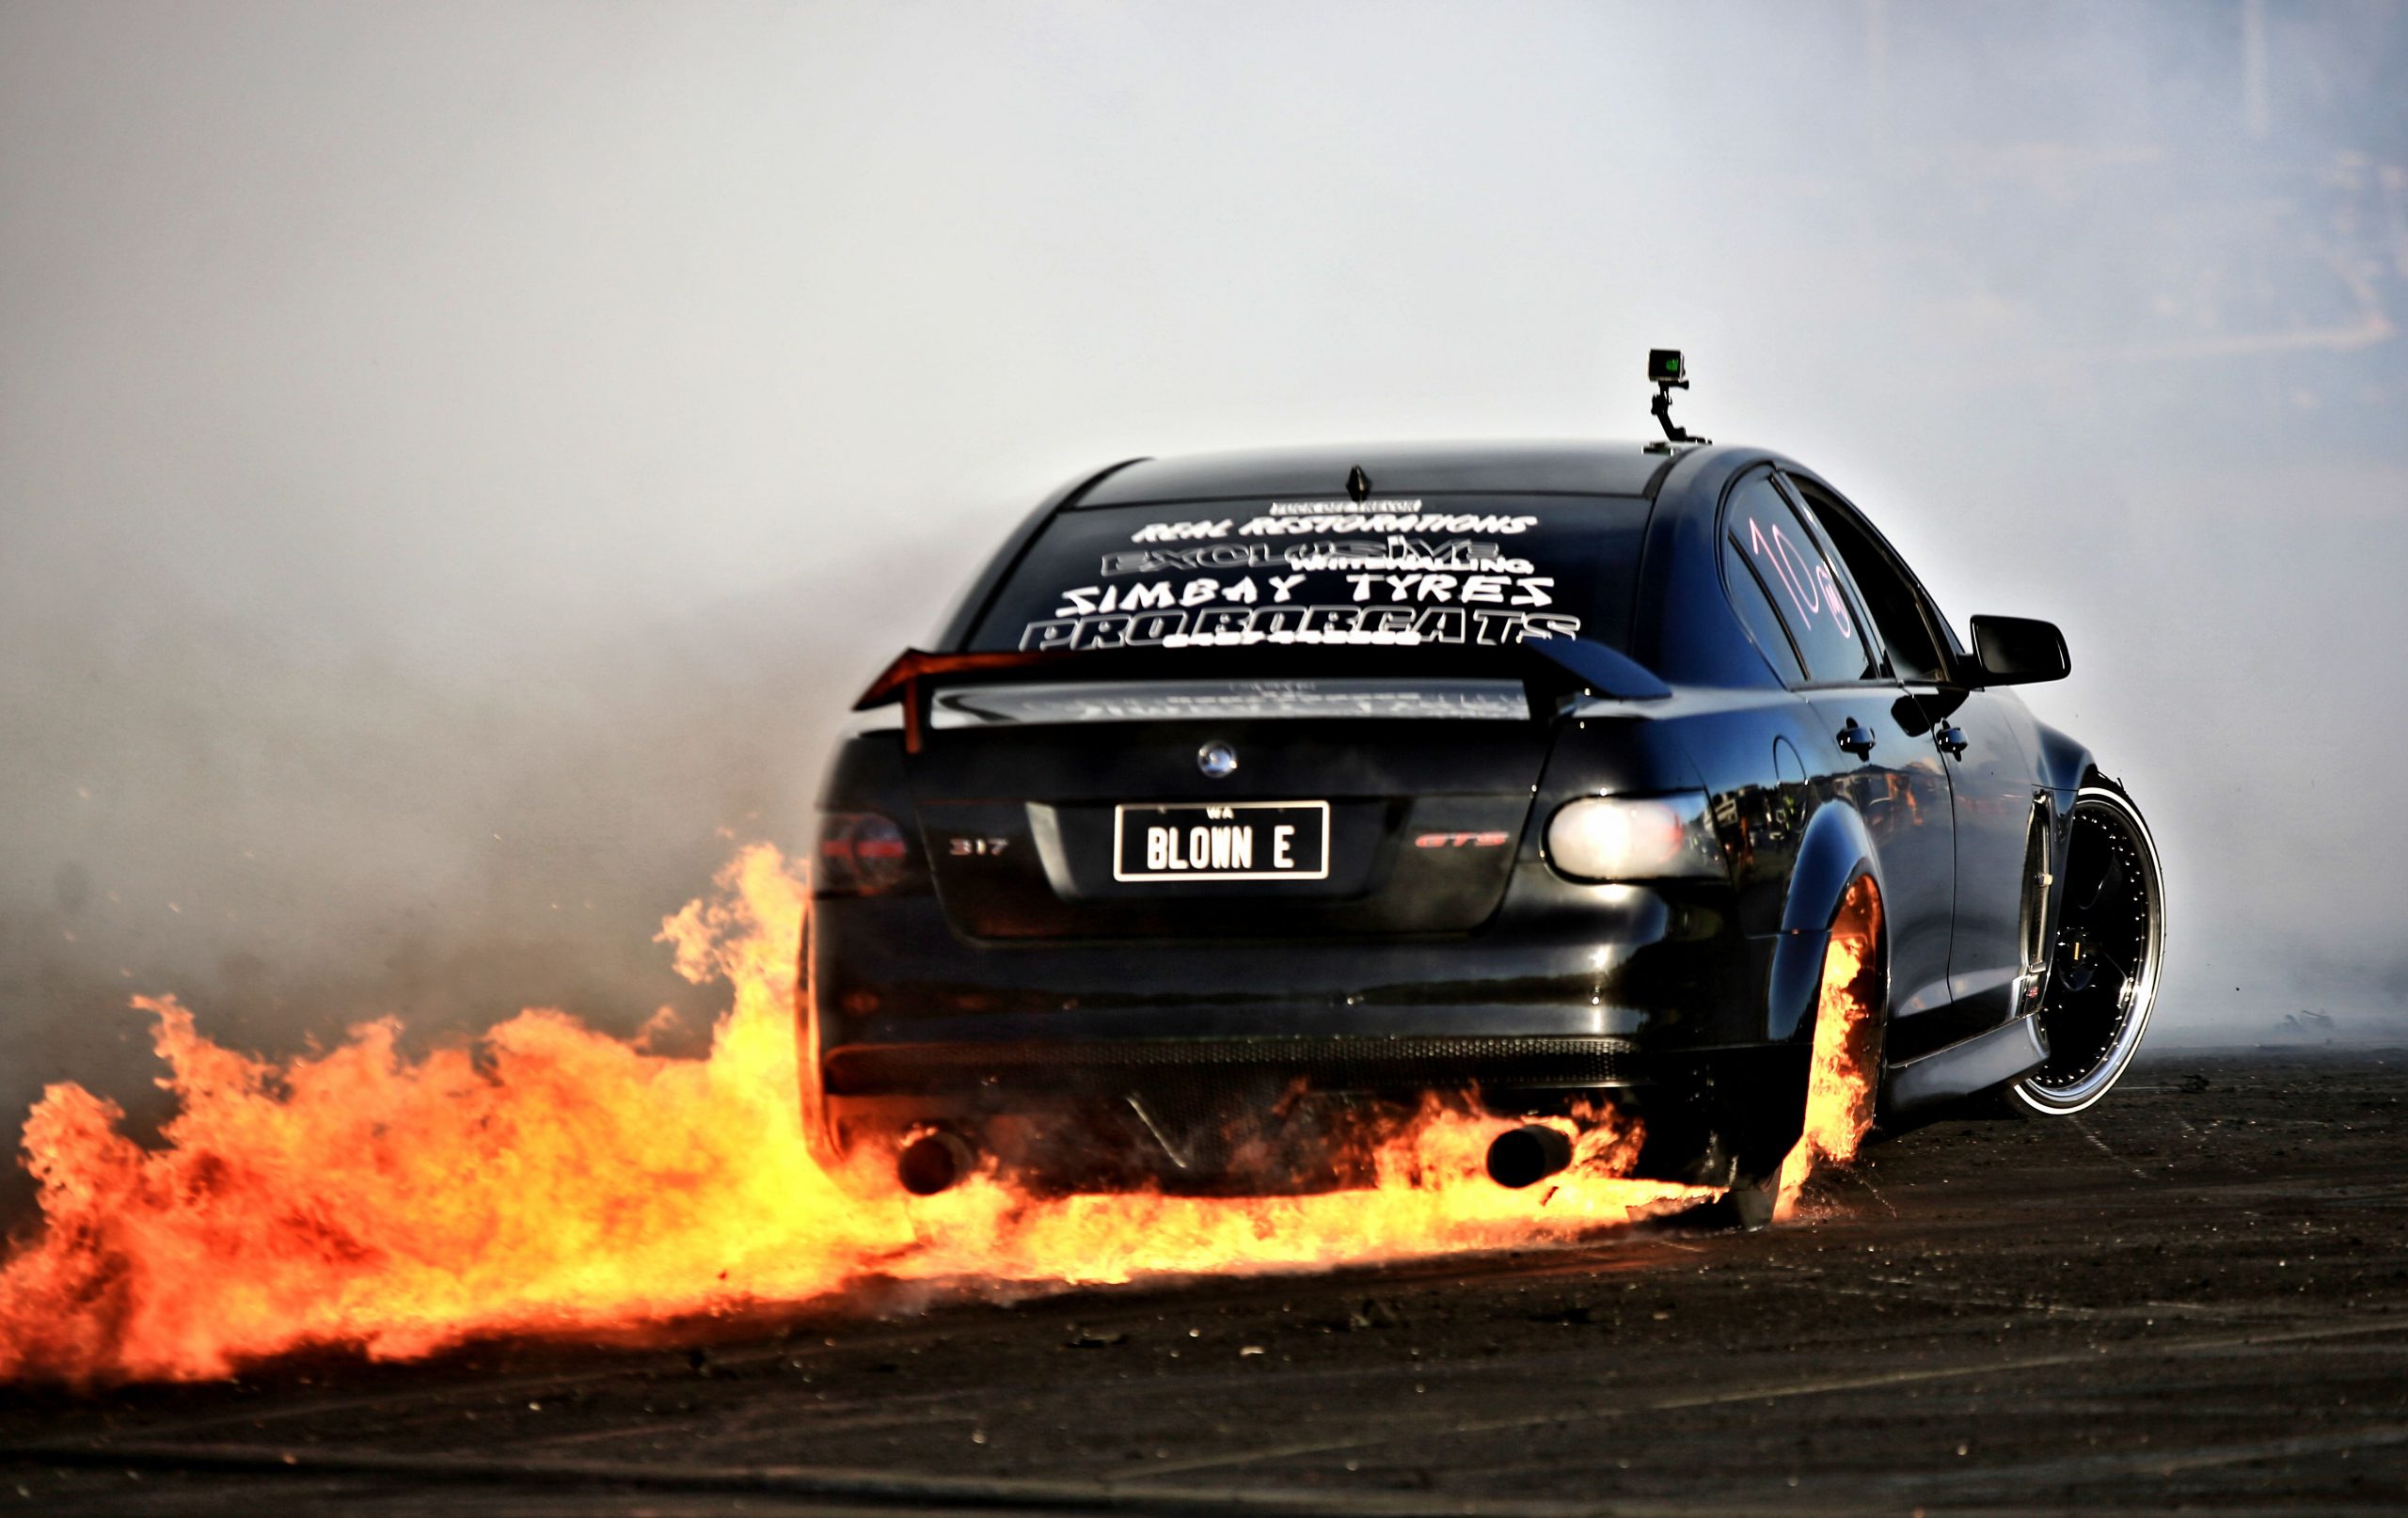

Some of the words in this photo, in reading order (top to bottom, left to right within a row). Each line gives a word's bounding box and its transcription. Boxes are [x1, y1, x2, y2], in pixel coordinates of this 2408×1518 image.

[1132, 518, 1234, 543] REAL
[1238, 514, 1538, 537] RESTORATIONS
[1055, 574, 1307, 618] SIMBAY
[1346, 573, 1554, 607] TYRES
[949, 838, 1008, 855] 317
[1147, 826, 1253, 870] BLOWN
[1273, 825, 1295, 868] E
[1414, 830, 1510, 847] GTS
